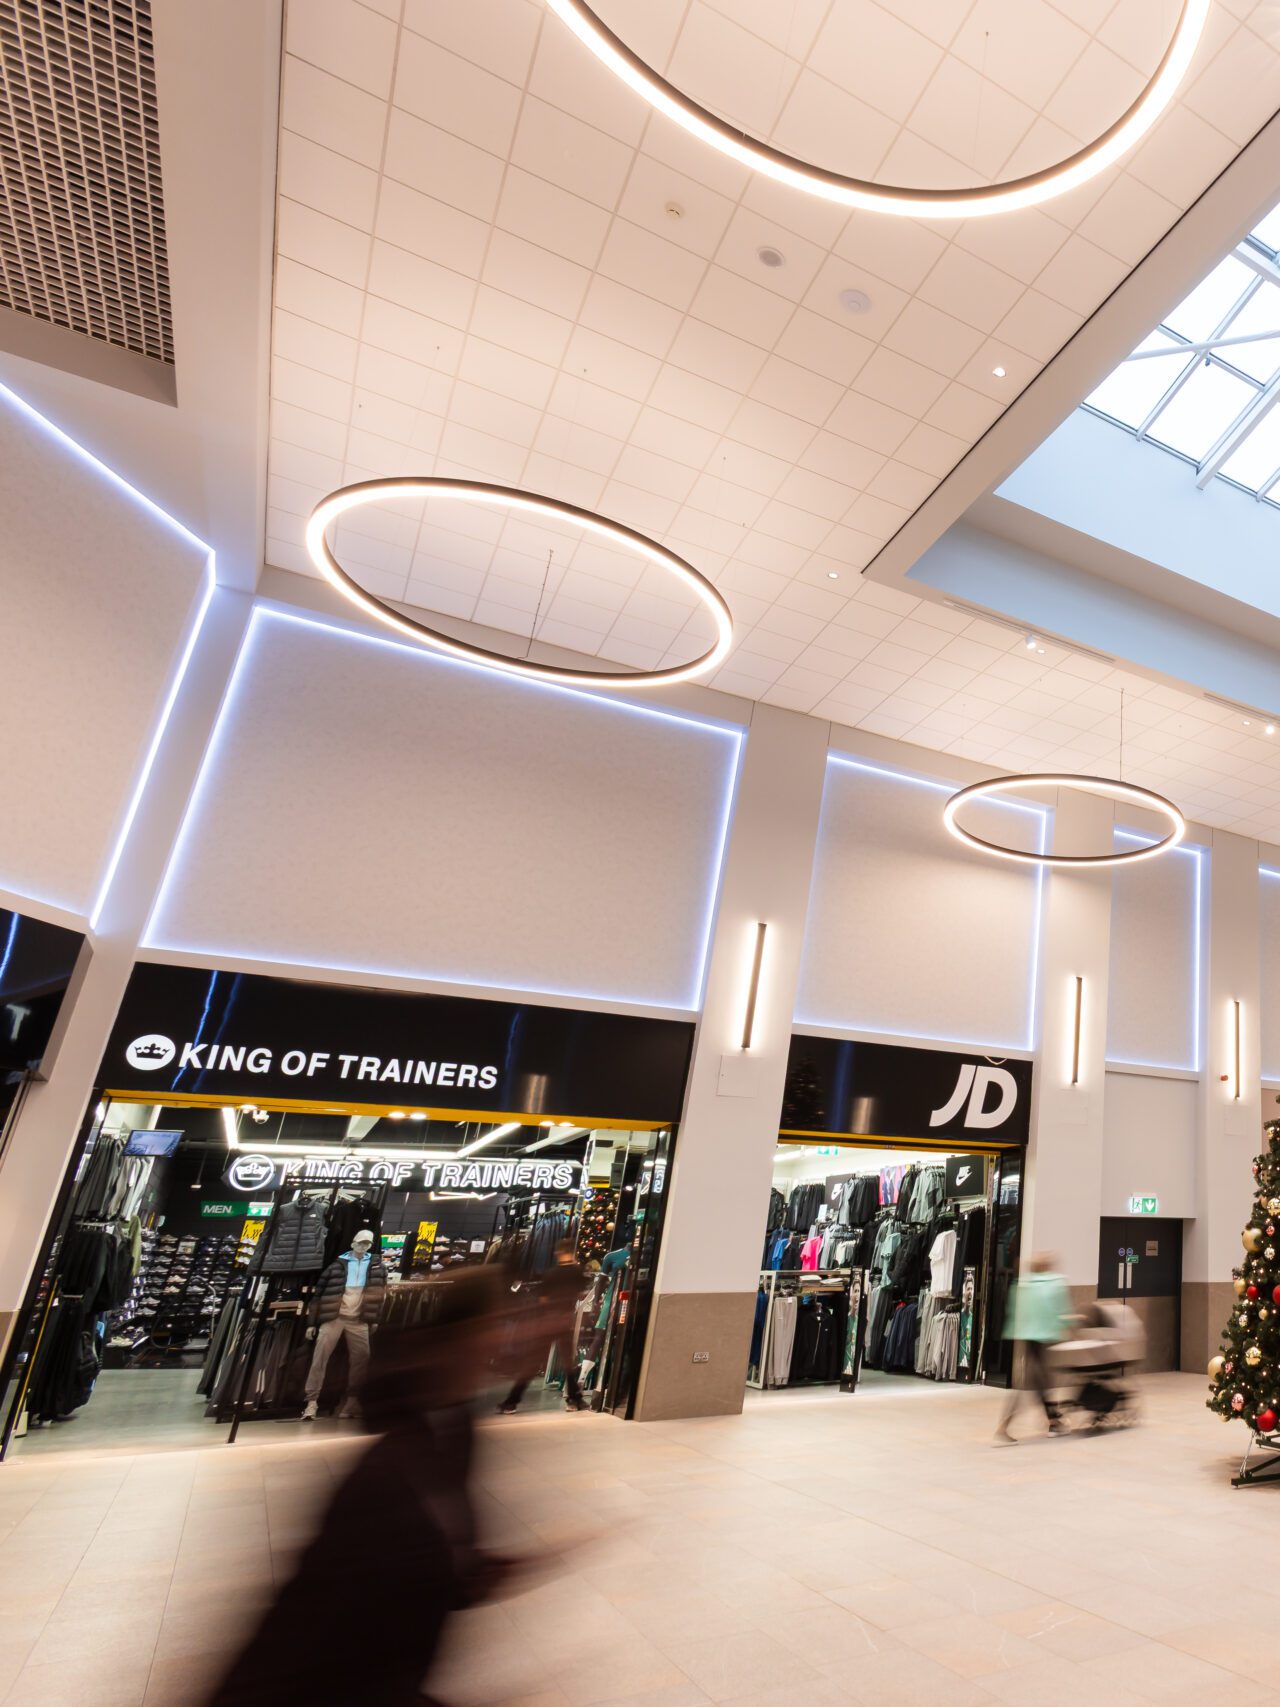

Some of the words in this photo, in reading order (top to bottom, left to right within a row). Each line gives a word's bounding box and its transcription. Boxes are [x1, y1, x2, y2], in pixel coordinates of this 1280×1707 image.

[178, 1042, 272, 1074] KING
[280, 1051, 331, 1077] OF
[337, 1055, 499, 1090] TRAINERS
[929, 1064, 1018, 1130] JD
[421, 1163, 573, 1190] TRAINERS
[203, 1205, 232, 1214] MEN
